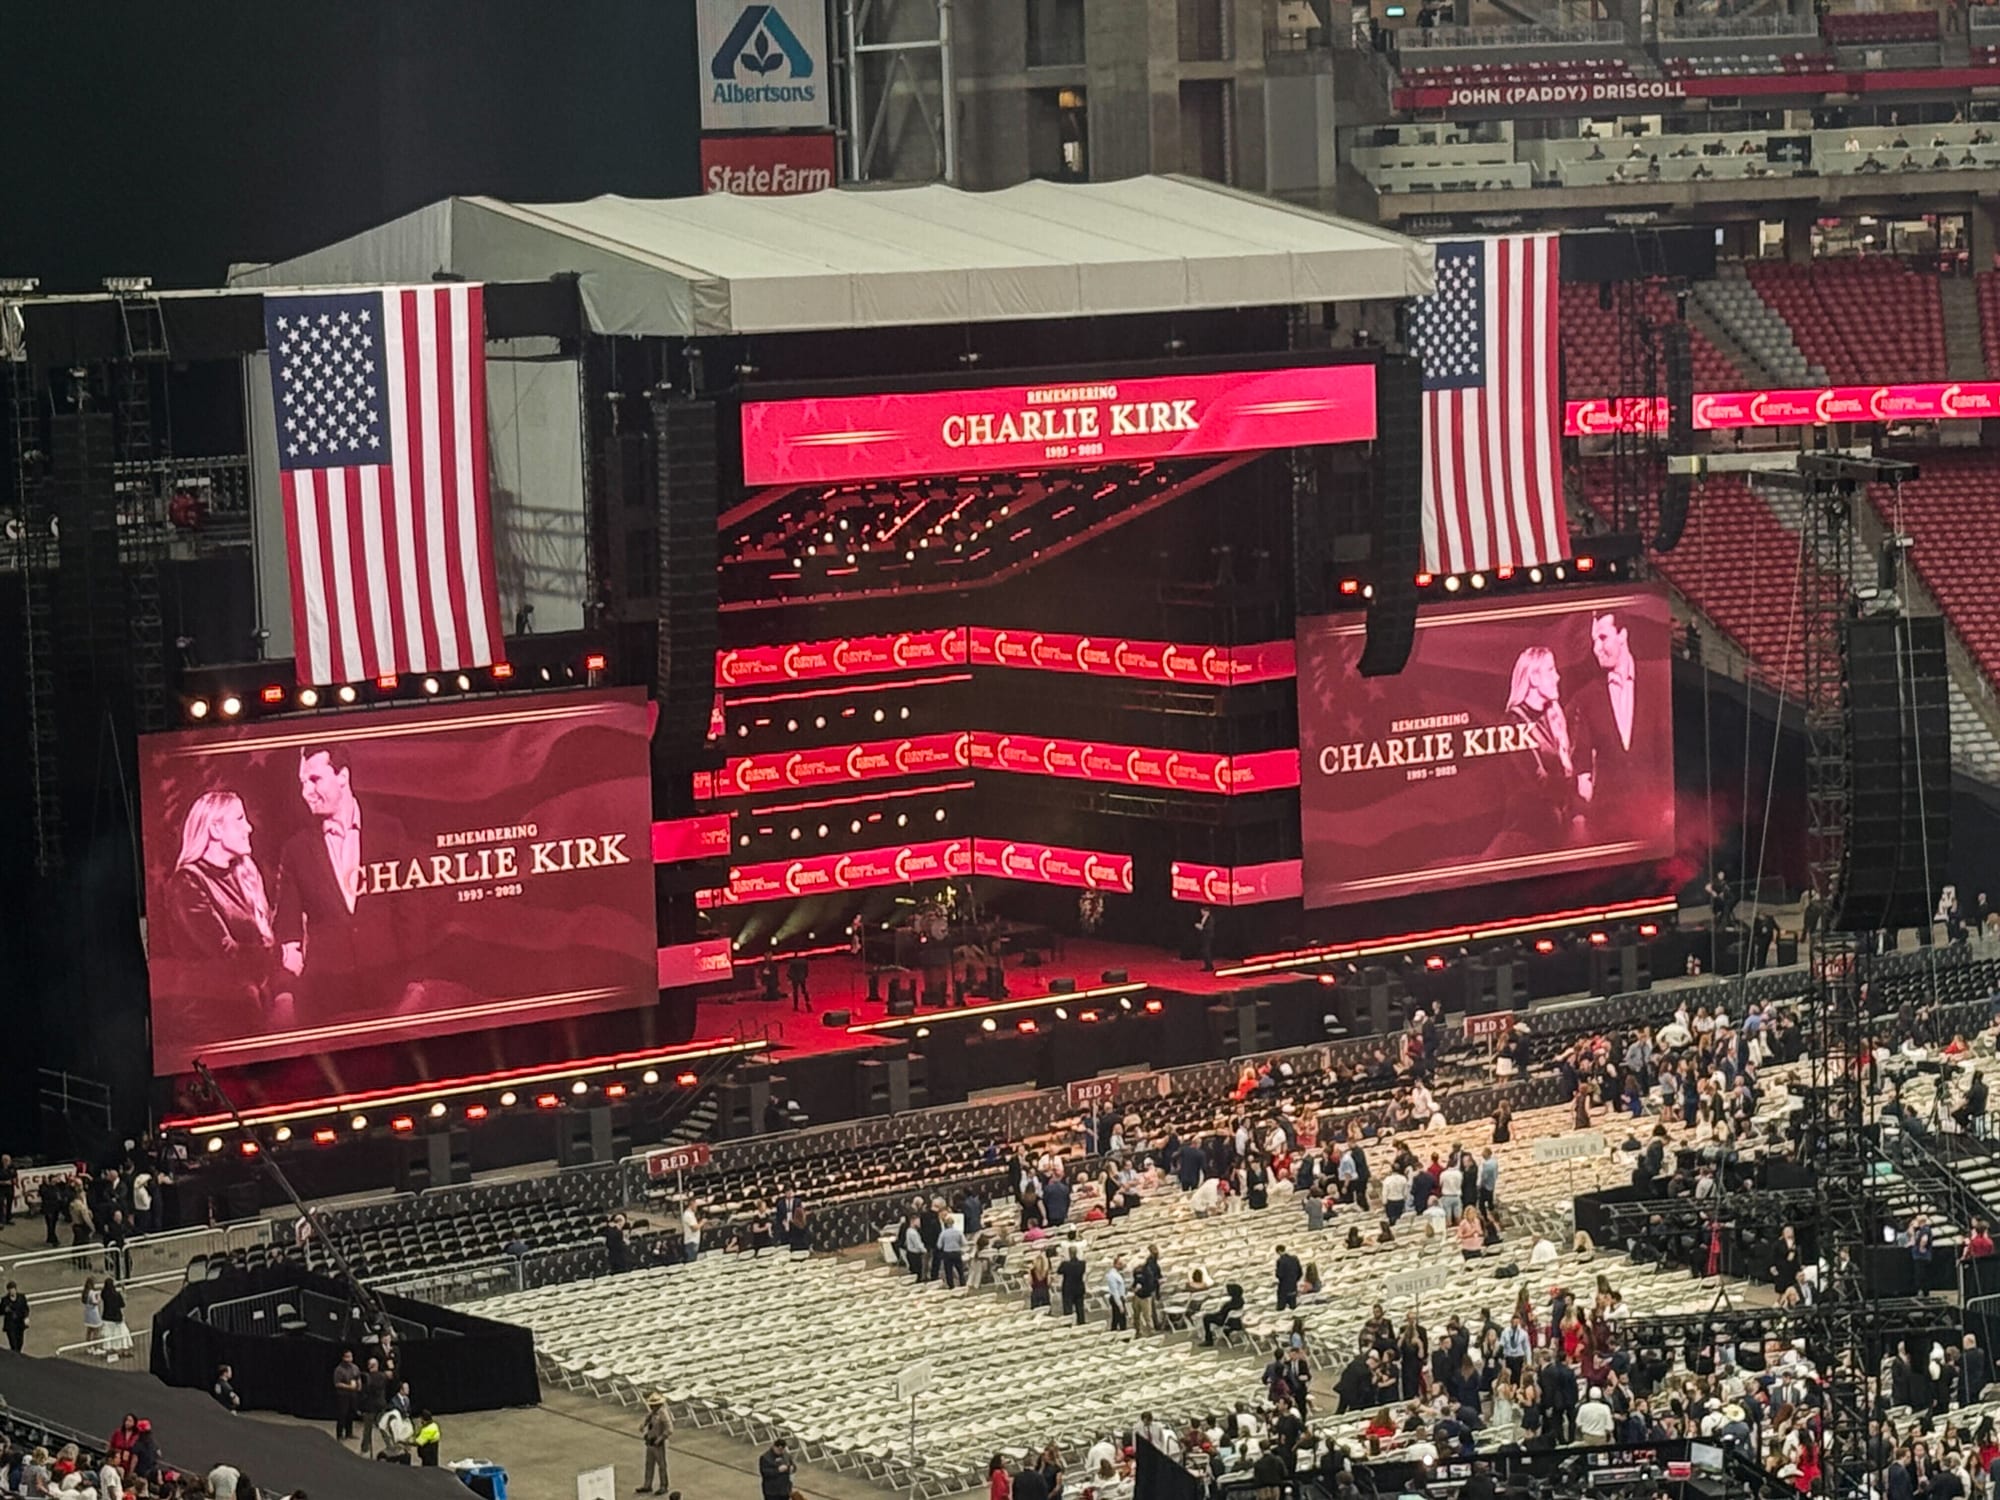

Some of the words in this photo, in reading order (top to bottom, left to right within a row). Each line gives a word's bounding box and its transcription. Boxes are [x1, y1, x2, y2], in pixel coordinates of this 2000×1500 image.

[713, 82, 815, 104] Albertsons
[1448, 88, 1501, 106] JOHN
[1506, 85, 1587, 105] (PADDY)
[1592, 81, 1687, 101] DRISCOLL
[1026, 385, 1118, 405] REMEMBERING
[942, 406, 1100, 448] CHARLIE
[1109, 399, 1199, 436] KIRK
[1391, 712, 1470, 734] REMEMBERING
[1319, 733, 1455, 776] CHARLIE
[1462, 721, 1540, 757] KIRK
[436, 823, 538, 848] REMEMBERING
[346, 846, 519, 897] CHARLIE
[530, 833, 631, 875] KIRK
[1473, 1020, 1497, 1034] RED
[1077, 1084, 1102, 1100] RED
[1104, 1083, 1112, 1094] 2
[660, 1154, 689, 1171] RED
[693, 1151, 700, 1163] 1
[1544, 1145, 1586, 1158] WHITE
[1395, 1278, 1432, 1293] WHITE
[1434, 1274, 1442, 1286] 7
